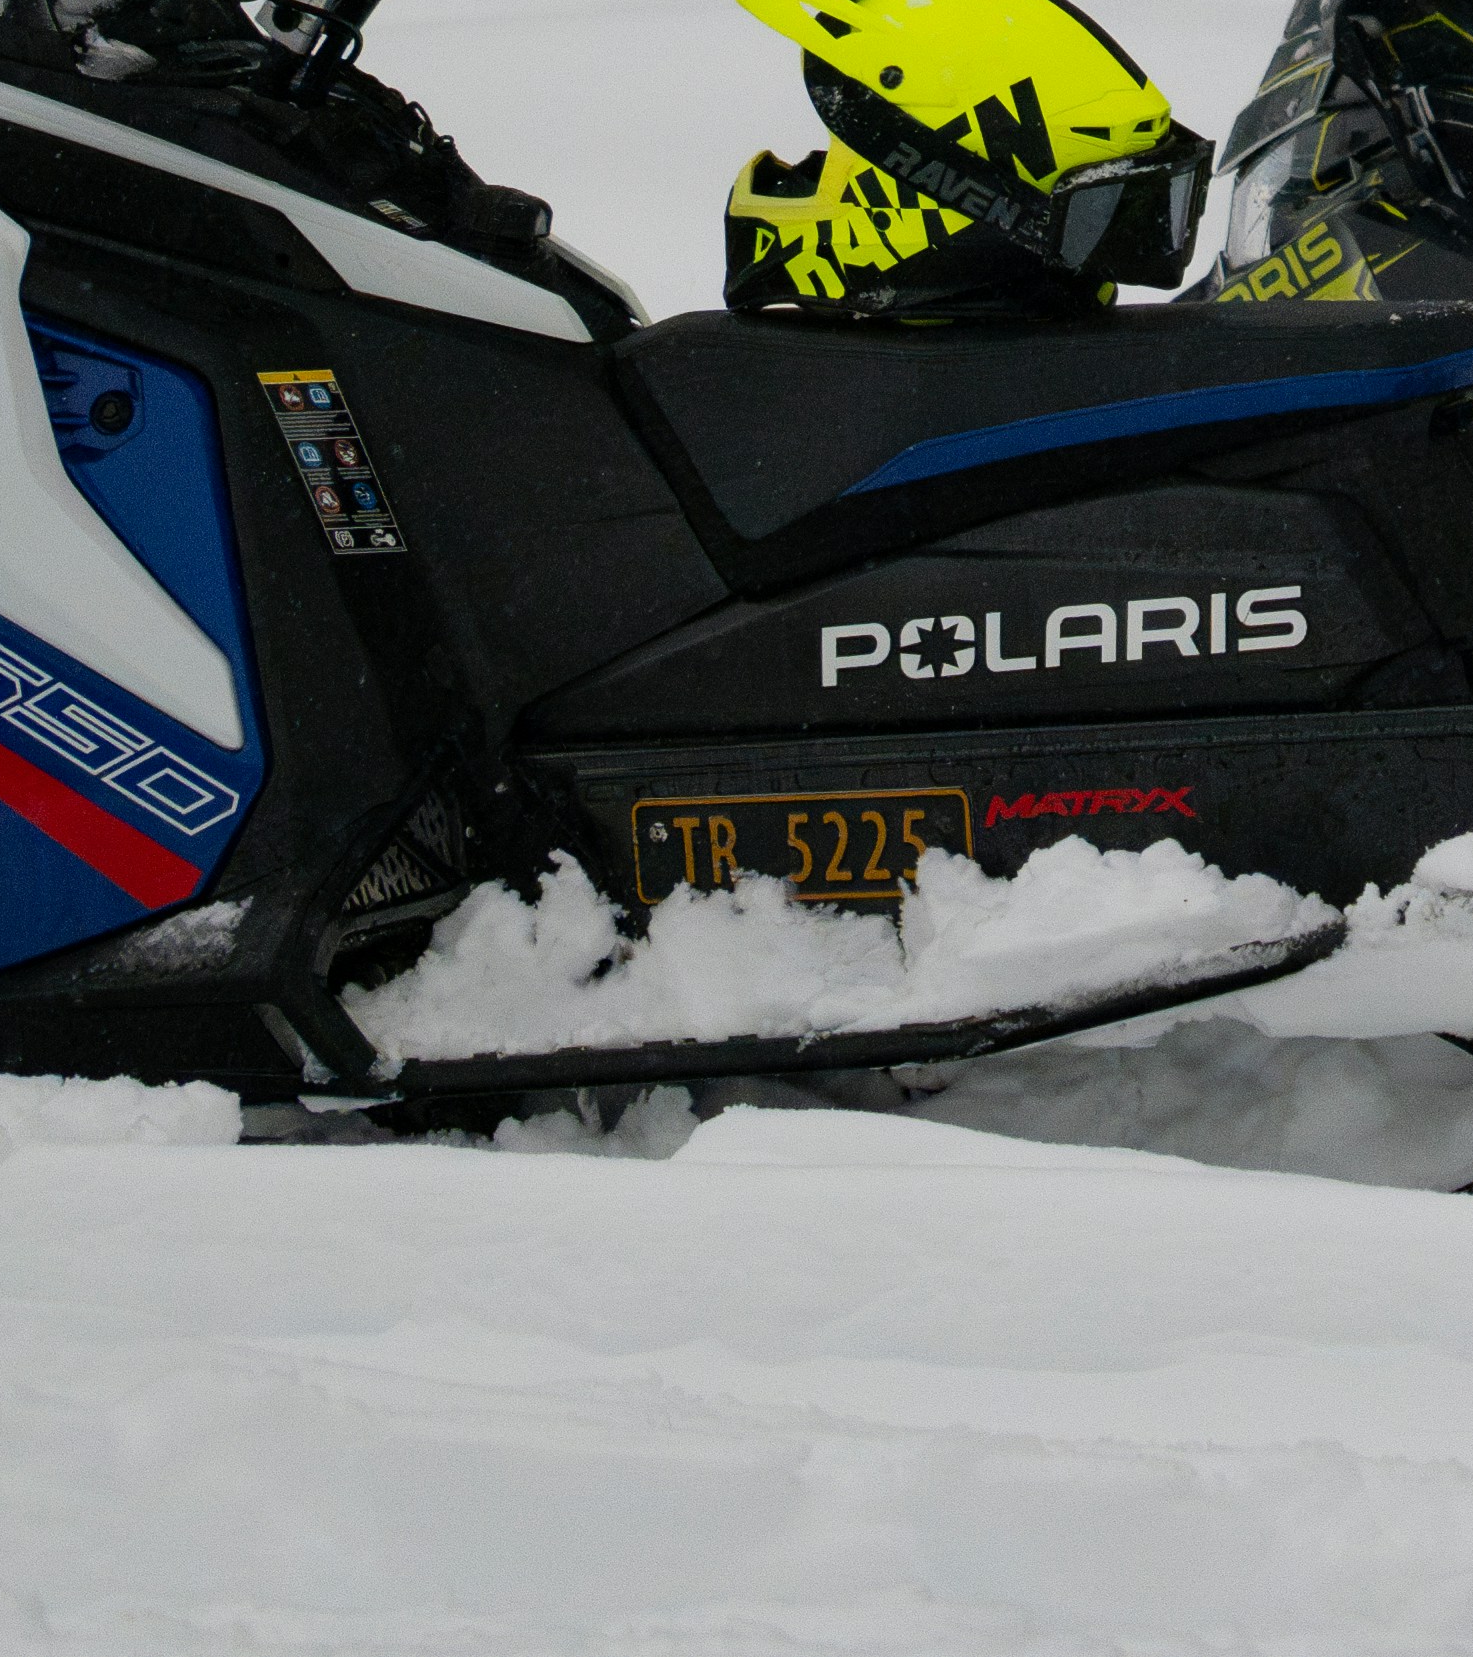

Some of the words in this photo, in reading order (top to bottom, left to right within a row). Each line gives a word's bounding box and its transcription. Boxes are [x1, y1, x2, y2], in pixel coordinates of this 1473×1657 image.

[882, 141, 1022, 231] RAVEN
[821, 585, 1308, 688] POLARIS
[673, 815, 737, 884] TR
[787, 808, 926, 883] 5225
[985, 785, 1199, 828] MATRYX
